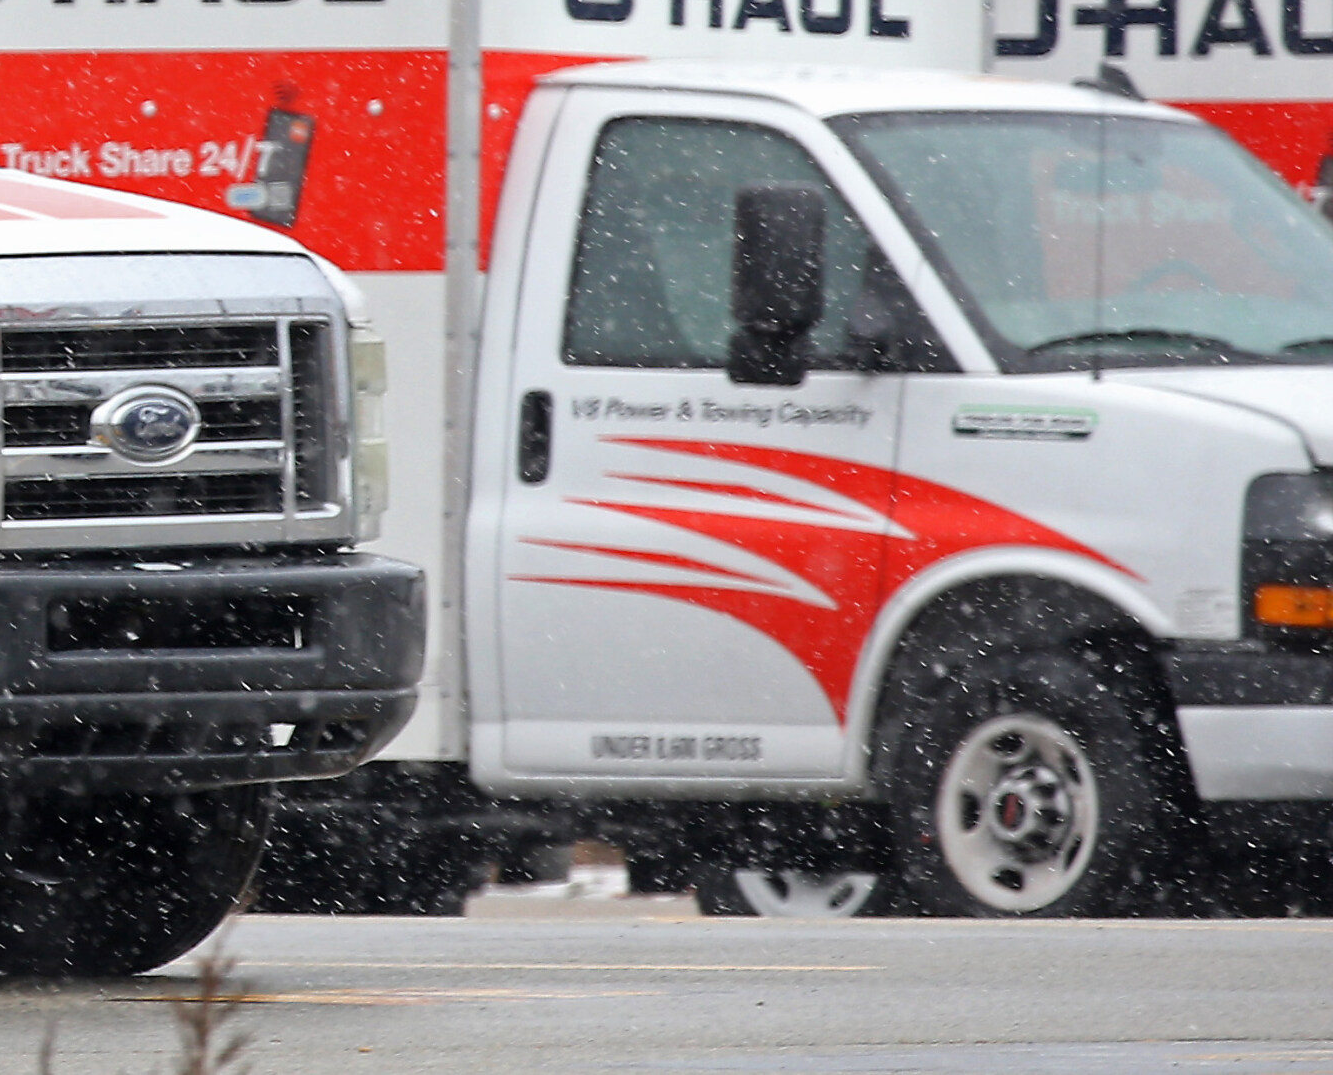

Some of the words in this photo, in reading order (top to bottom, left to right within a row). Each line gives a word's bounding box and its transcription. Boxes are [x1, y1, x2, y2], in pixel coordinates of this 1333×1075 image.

[0, 141, 91, 176] Truck
[99, 141, 194, 177] Share
[199, 135, 282, 181] 24/7
[605, 397, 671, 421] Power
[676, 398, 692, 421] &
[700, 398, 774, 428] Towing
[779, 398, 873, 428] Capacity
